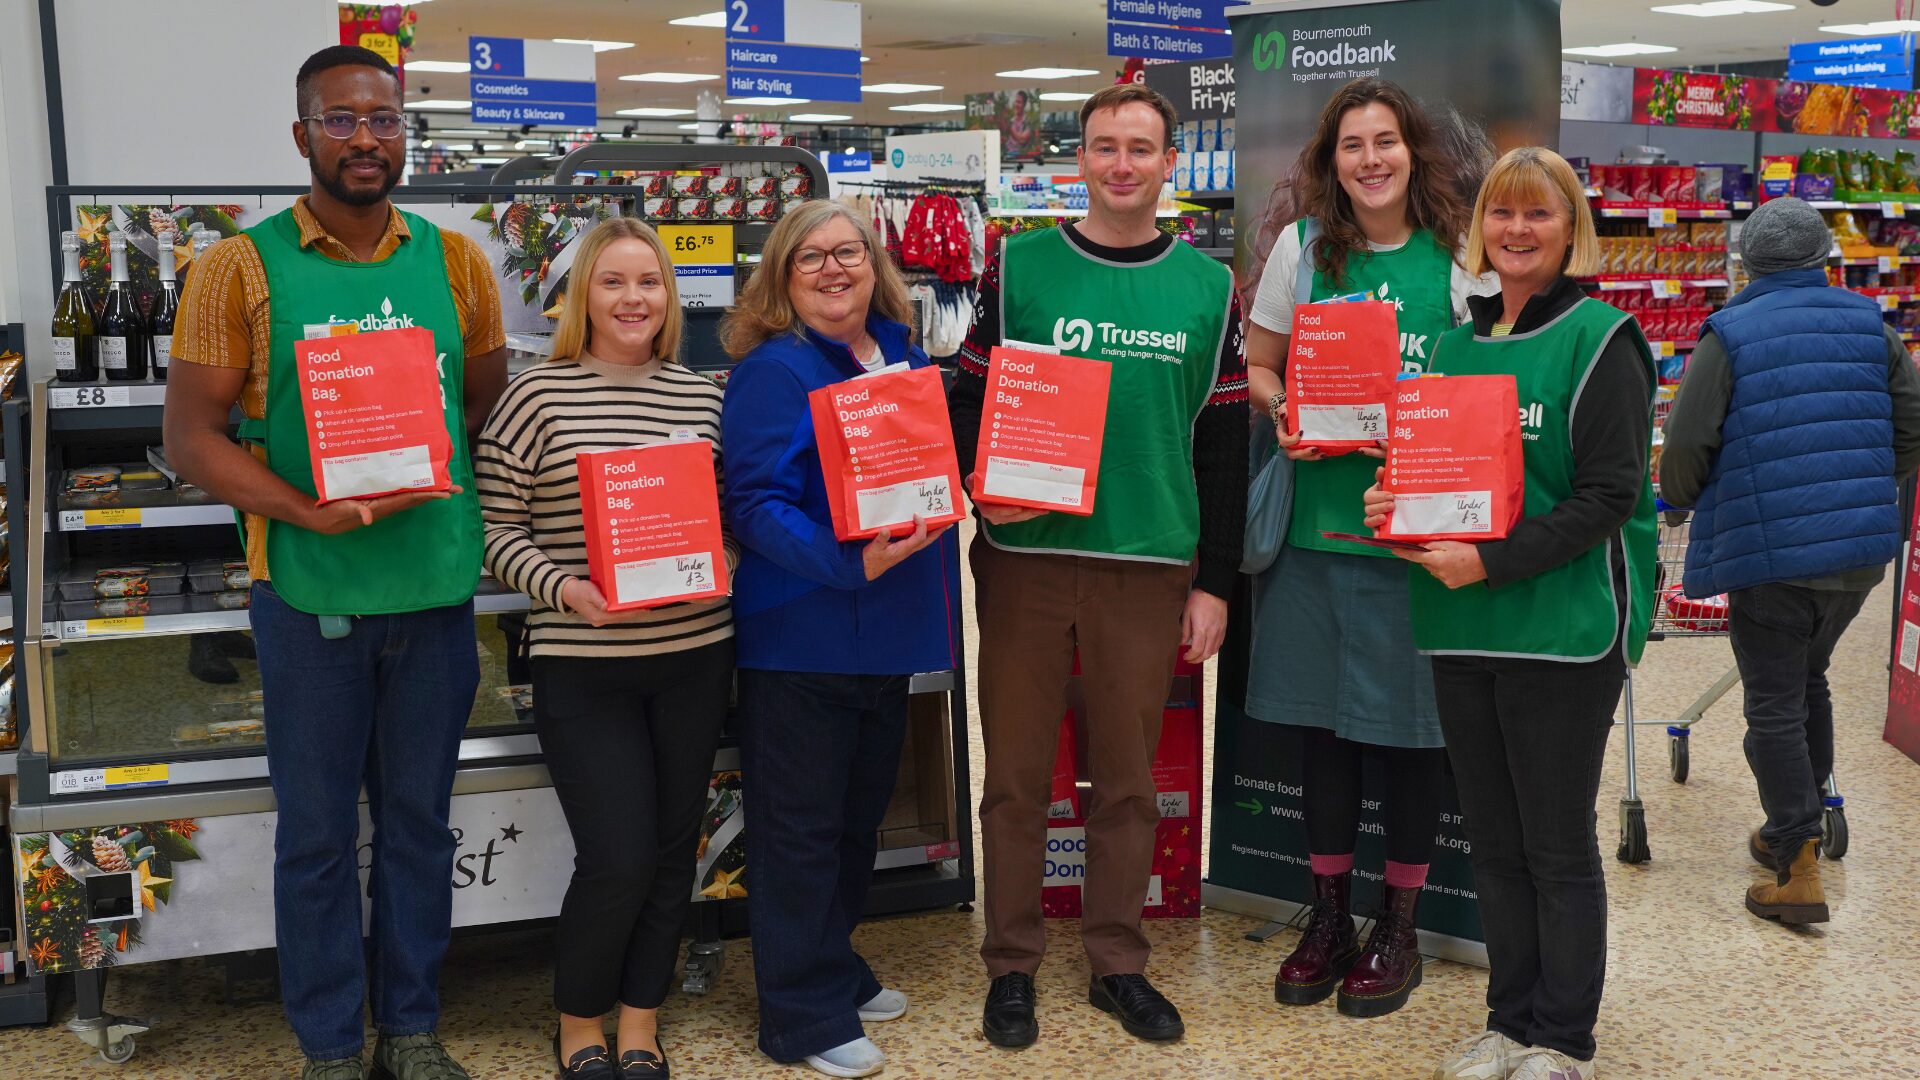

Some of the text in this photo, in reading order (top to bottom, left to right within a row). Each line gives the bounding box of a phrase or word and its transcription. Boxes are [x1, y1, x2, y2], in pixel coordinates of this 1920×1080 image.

[731, 0, 758, 33] 2.
[1113, 0, 1202, 20] Female Hygiene
[1293, 24, 1371, 41] Bournemouth
[374, 38, 385, 47] for
[1113, 32, 1203, 54] Bath & Toiletries
[1820, 43, 1882, 55] Female Hygiene
[475, 42, 501, 70] 3.
[731, 48, 778, 63] Haircare
[1292, 40, 1396, 69] Foodbank
[1190, 63, 1235, 87] Black
[1292, 68, 1380, 84] Together with Trussell
[1814, 65, 1847, 75] Washing
[475, 83, 529, 96] Cosmetics
[731, 77, 792, 95] Hair Styling
[1687, 86, 1715, 101] MERRY
[968, 100, 995, 117] Fruit
[1191, 88, 1235, 114] Fri-ya
[1675, 99, 1725, 117] CHRISTMAS
[476, 106, 565, 121] Beauty & Skincare
[907, 153, 929, 168] baby
[929, 153, 953, 168] 0-24
[1194, 227, 1208, 236] NESS
[1219, 227, 1235, 236] GUIN
[675, 236, 714, 251] £6.75
[328, 314, 415, 331] fdbank
[1299, 314, 1321, 325] Food
[1097, 322, 1187, 354] Trussell
[1298, 330, 1346, 341] Donation
[307, 349, 341, 365] Food
[1101, 347, 1183, 365] Ending hunger together
[1296, 345, 1317, 358] Bag.
[308, 365, 374, 383] Donation
[1000, 359, 1035, 375] Food
[998, 375, 1059, 395] Donation
[76, 387, 106, 406] £8
[312, 387, 341, 401] Bag.
[836, 389, 870, 406] Food
[996, 392, 1023, 408] Bag.
[1397, 390, 1420, 404] Food
[839, 401, 899, 422] Donation
[1357, 411, 1381, 421] Under
[1396, 406, 1449, 422] Donation
[843, 425, 873, 439] Bag.
[1394, 426, 1415, 441] Bag.
[1521, 432, 1540, 441] ther
[604, 460, 636, 476] Food
[605, 475, 665, 493] Donation
[919, 485, 947, 498] Under
[607, 497, 635, 510] Bag.
[1457, 498, 1486, 510] Under
[676, 559, 705, 572] Under
[1234, 774, 1303, 797] Donate food
[1232, 844, 1312, 867] Registered Charity Num
[1422, 881, 1478, 899] gland and Wal
